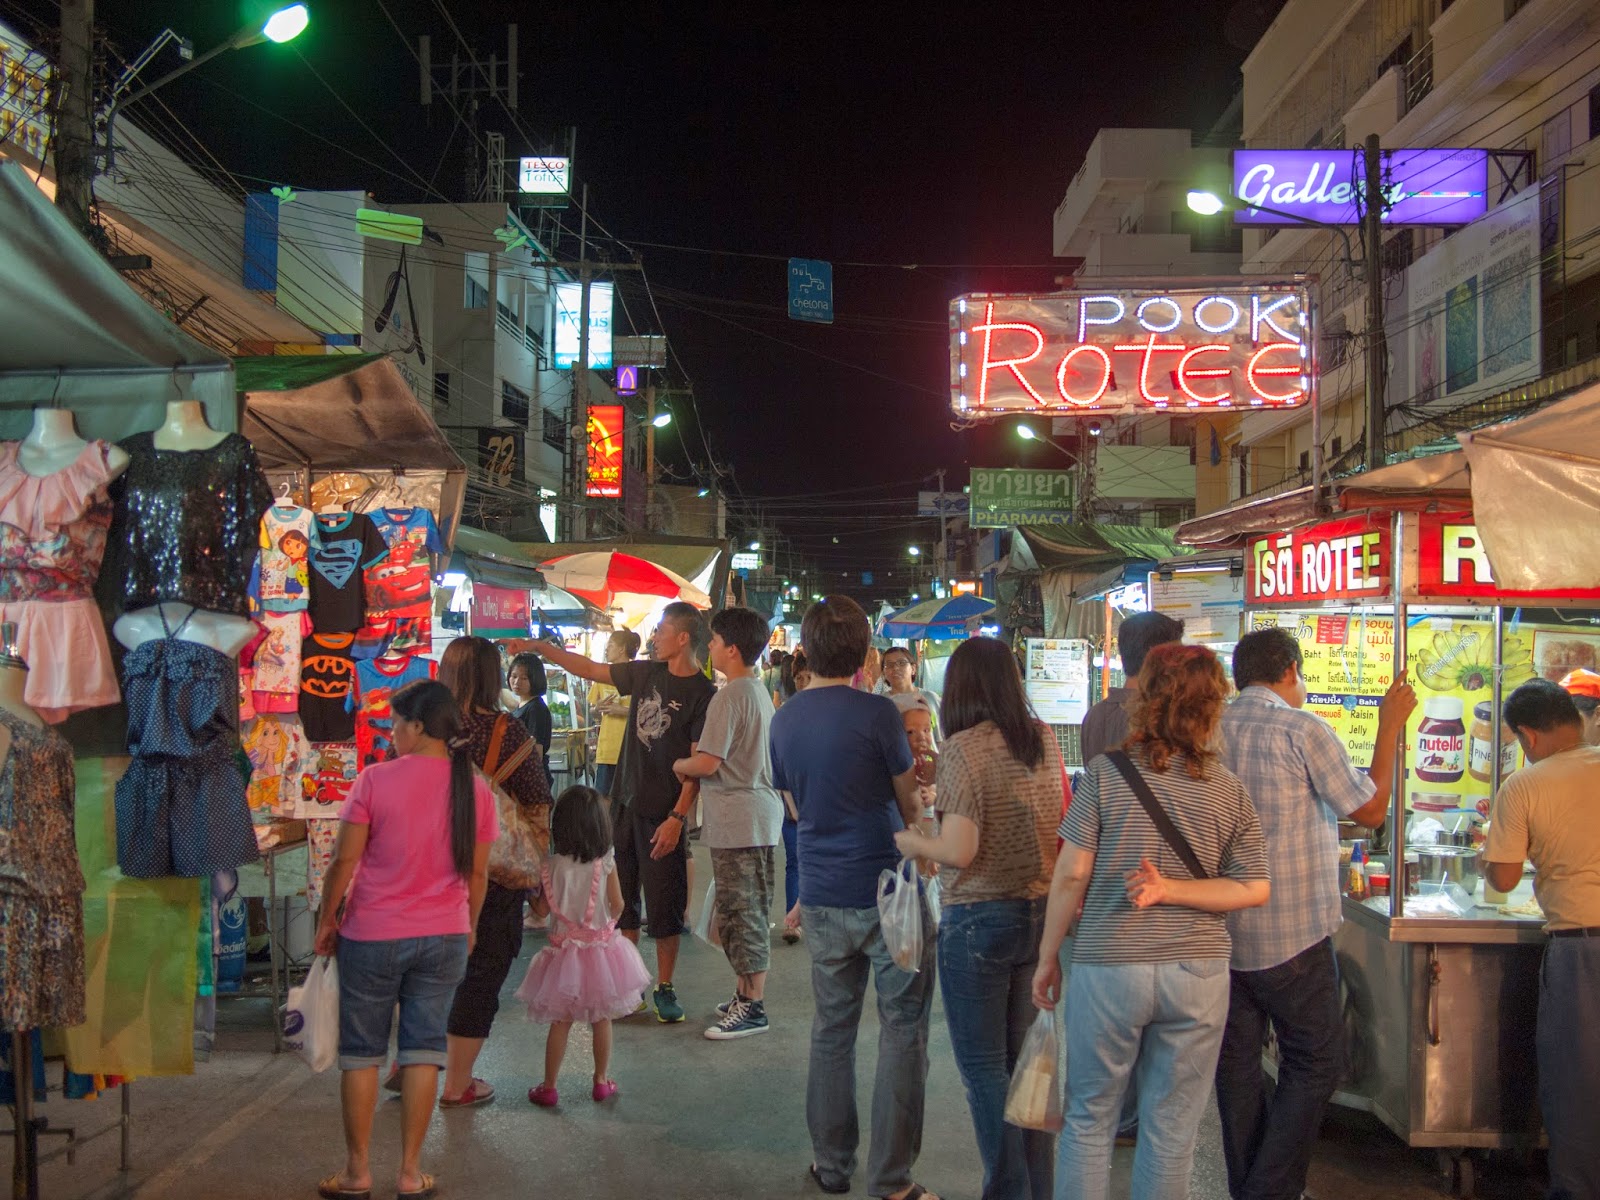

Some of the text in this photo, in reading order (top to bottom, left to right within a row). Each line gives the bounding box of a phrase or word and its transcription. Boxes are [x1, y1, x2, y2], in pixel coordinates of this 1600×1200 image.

[525, 161, 565, 169] TESCO
[1238, 161, 1407, 219] Galley
[1078, 296, 1300, 342] POOK
[976, 473, 1070, 496] ขายยา
[976, 511, 1071, 526] PHARMACY
[1254, 532, 1380, 597] โรตี ROTEE
[1304, 649, 1322, 659] Baht
[1379, 652, 1391, 662] 30
[1378, 675, 1390, 685] 40
[1358, 698, 1378, 706] Baht
[1350, 710, 1374, 719] Raisin
[1349, 725, 1367, 736] Jelly
[1419, 735, 1463, 752] nutella
